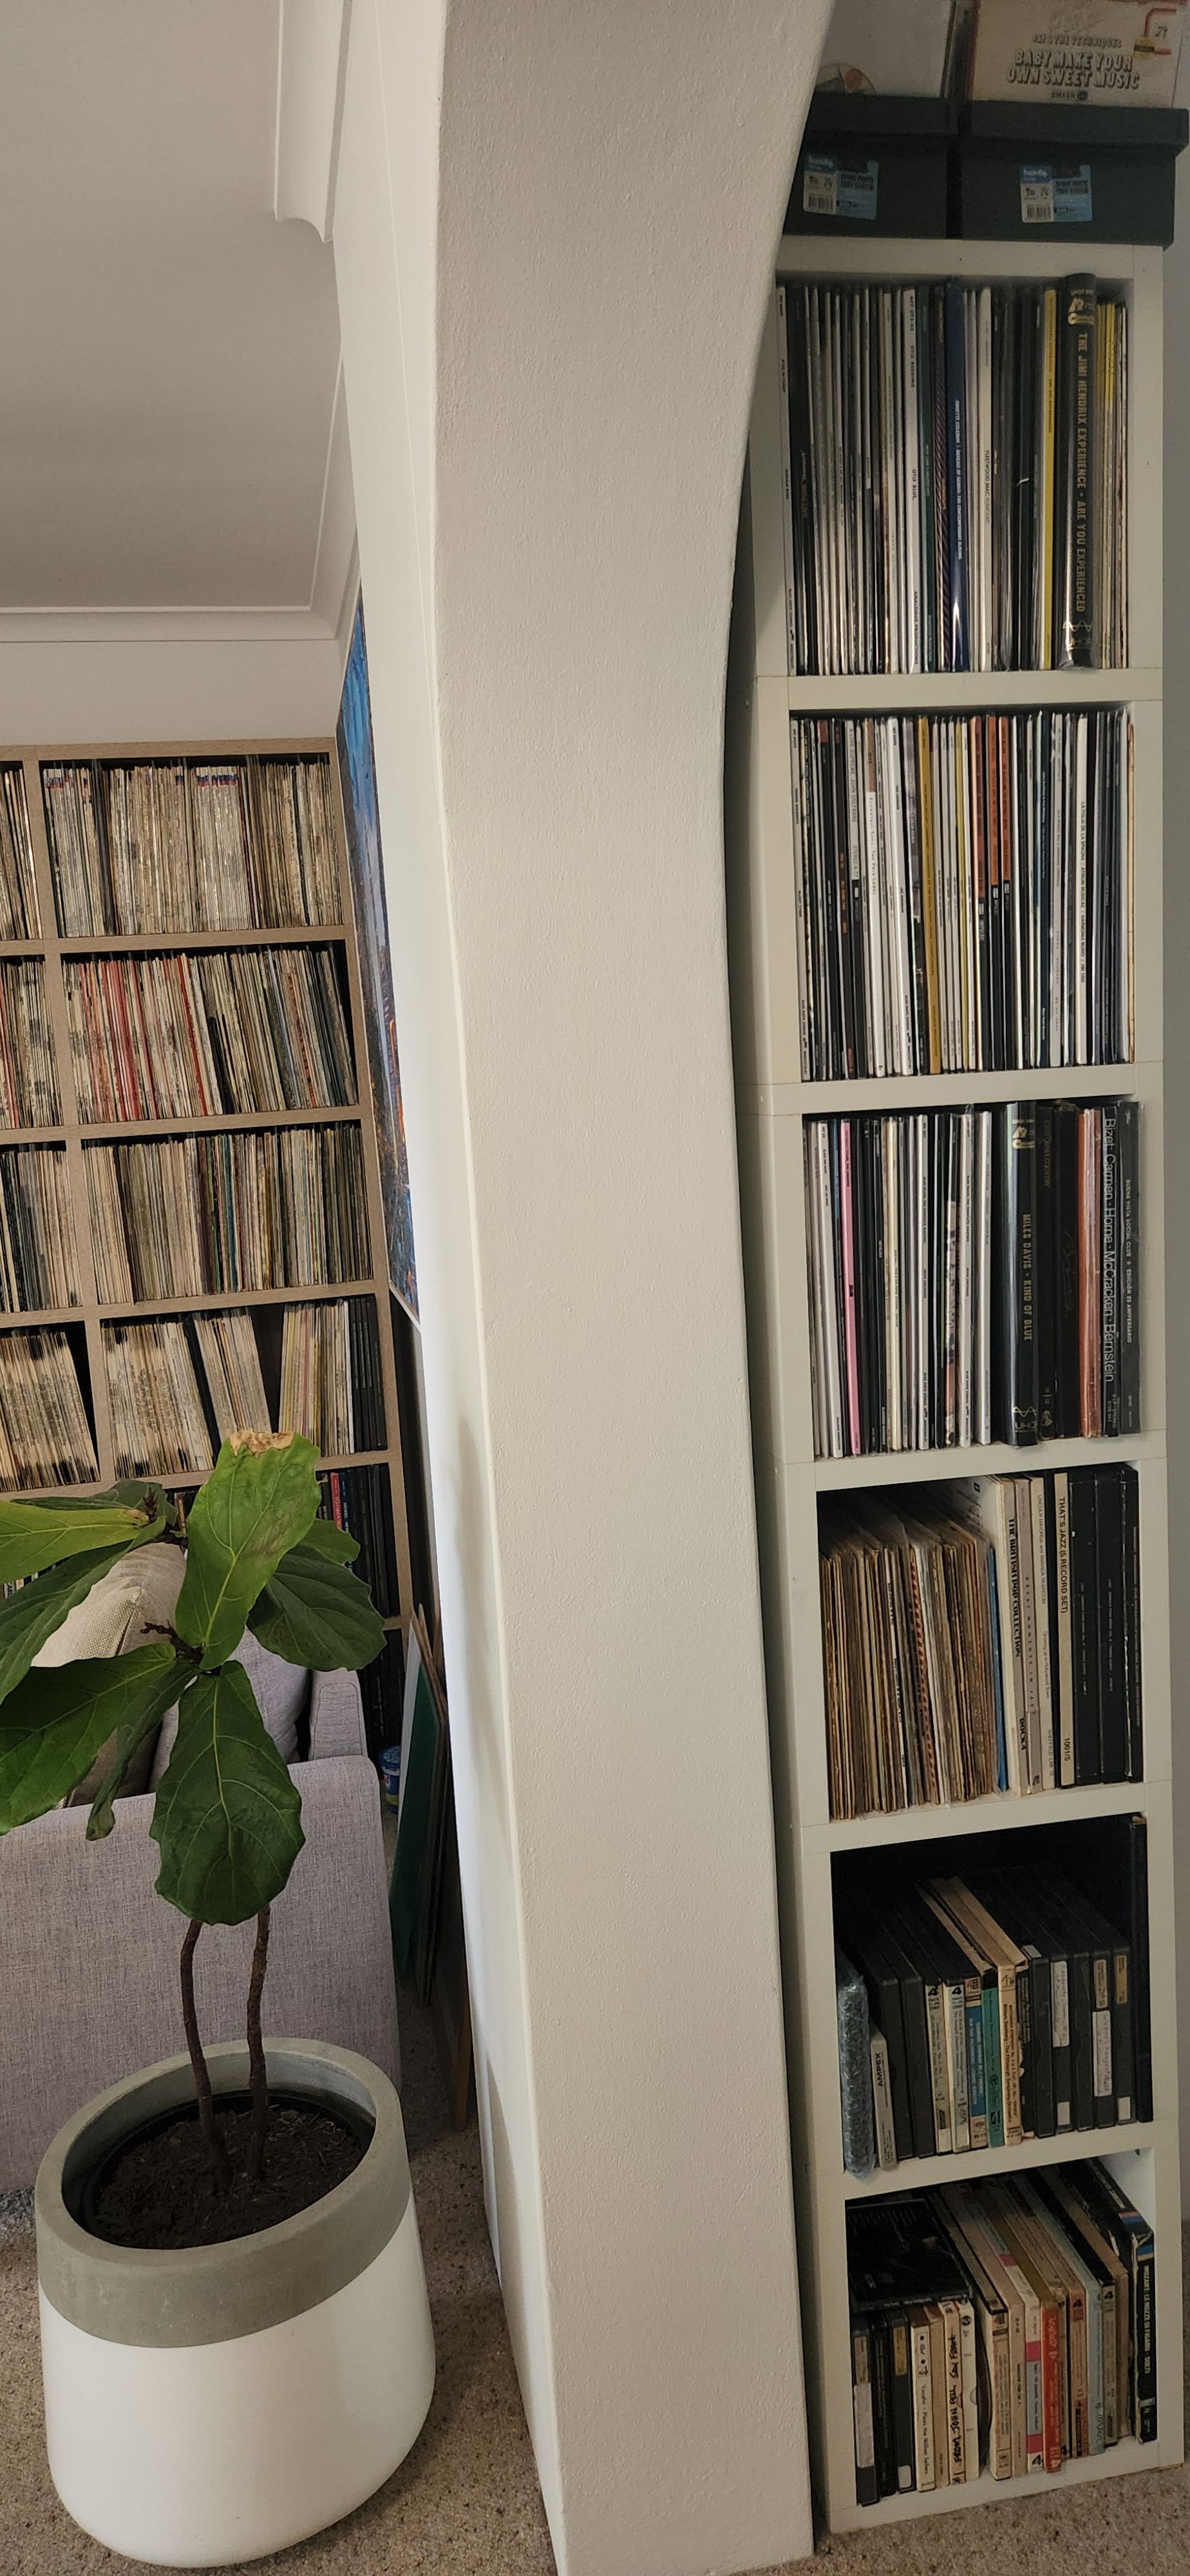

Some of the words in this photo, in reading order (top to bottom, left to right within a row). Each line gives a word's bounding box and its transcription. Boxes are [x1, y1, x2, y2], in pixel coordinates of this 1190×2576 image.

[1070, 36, 1122, 49] TECHNIQUES
[1015, 49, 1052, 67] BABY
[1052, 51, 1091, 70] MAKE
[1092, 53, 1133, 73] YOUR
[1006, 67, 1040, 84] OWN
[1042, 68, 1091, 88] SWEET
[1093, 72, 1140, 90] MUSIC
[1078, 333, 1088, 352] THE
[1077, 355, 1088, 377] JIMI
[1077, 381, 1088, 424] HENDRIX
[1077, 428, 1088, 489] EXPERIENCE
[1077, 501, 1086, 520] ARE
[1077, 524, 1086, 545] YOU
[1077, 549, 1086, 612] EXPERIENCED
[1104, 1154, 1116, 1200] Carmen
[1023, 1214, 1031, 1239] MILES
[1104, 1208, 1115, 1243] Horne
[1023, 1243, 1032, 1269] DAVIS
[1023, 1280, 1032, 1301] KIND
[1104, 1251, 1115, 1316] McCracken
[1023, 1305, 1032, 1316] OF
[1023, 1320, 1032, 1340] BLUE
[1104, 1324, 1116, 1382] Bernstein
[1010, 1539, 1018, 1578] BRITISH
[1013, 1600, 1021, 1657] COLLECTION
[875, 2052, 883, 2087] AMPEX
[950, 2407, 959, 2433] JOHN
[953, 2436, 962, 2463] FROM
